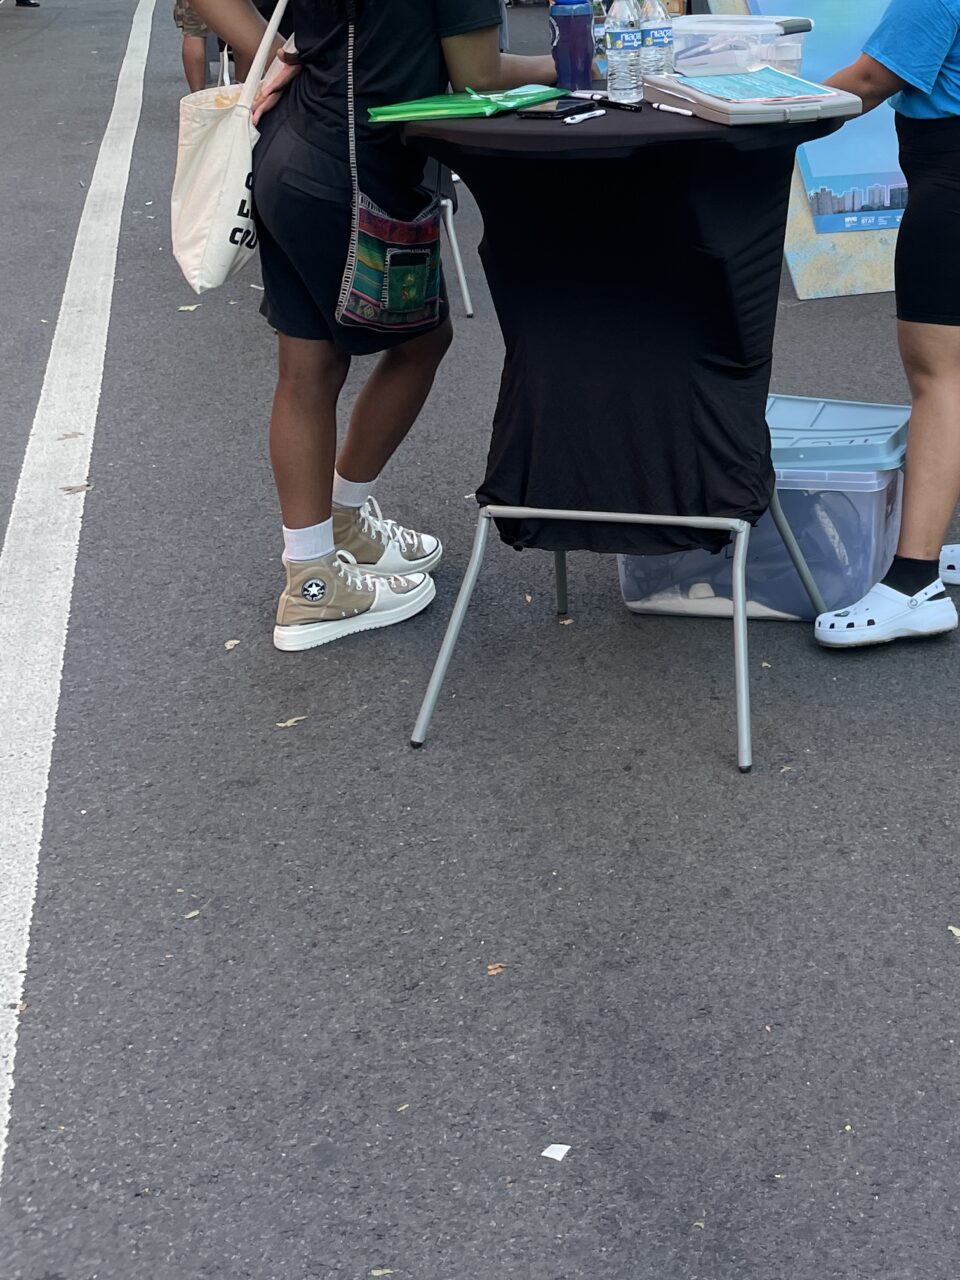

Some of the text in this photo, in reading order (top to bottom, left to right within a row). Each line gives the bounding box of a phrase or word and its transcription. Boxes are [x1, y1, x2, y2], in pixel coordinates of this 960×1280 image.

[621, 30, 641, 42] niaga
[650, 29, 672, 40] niaga
[230, 227, 258, 250] COU
